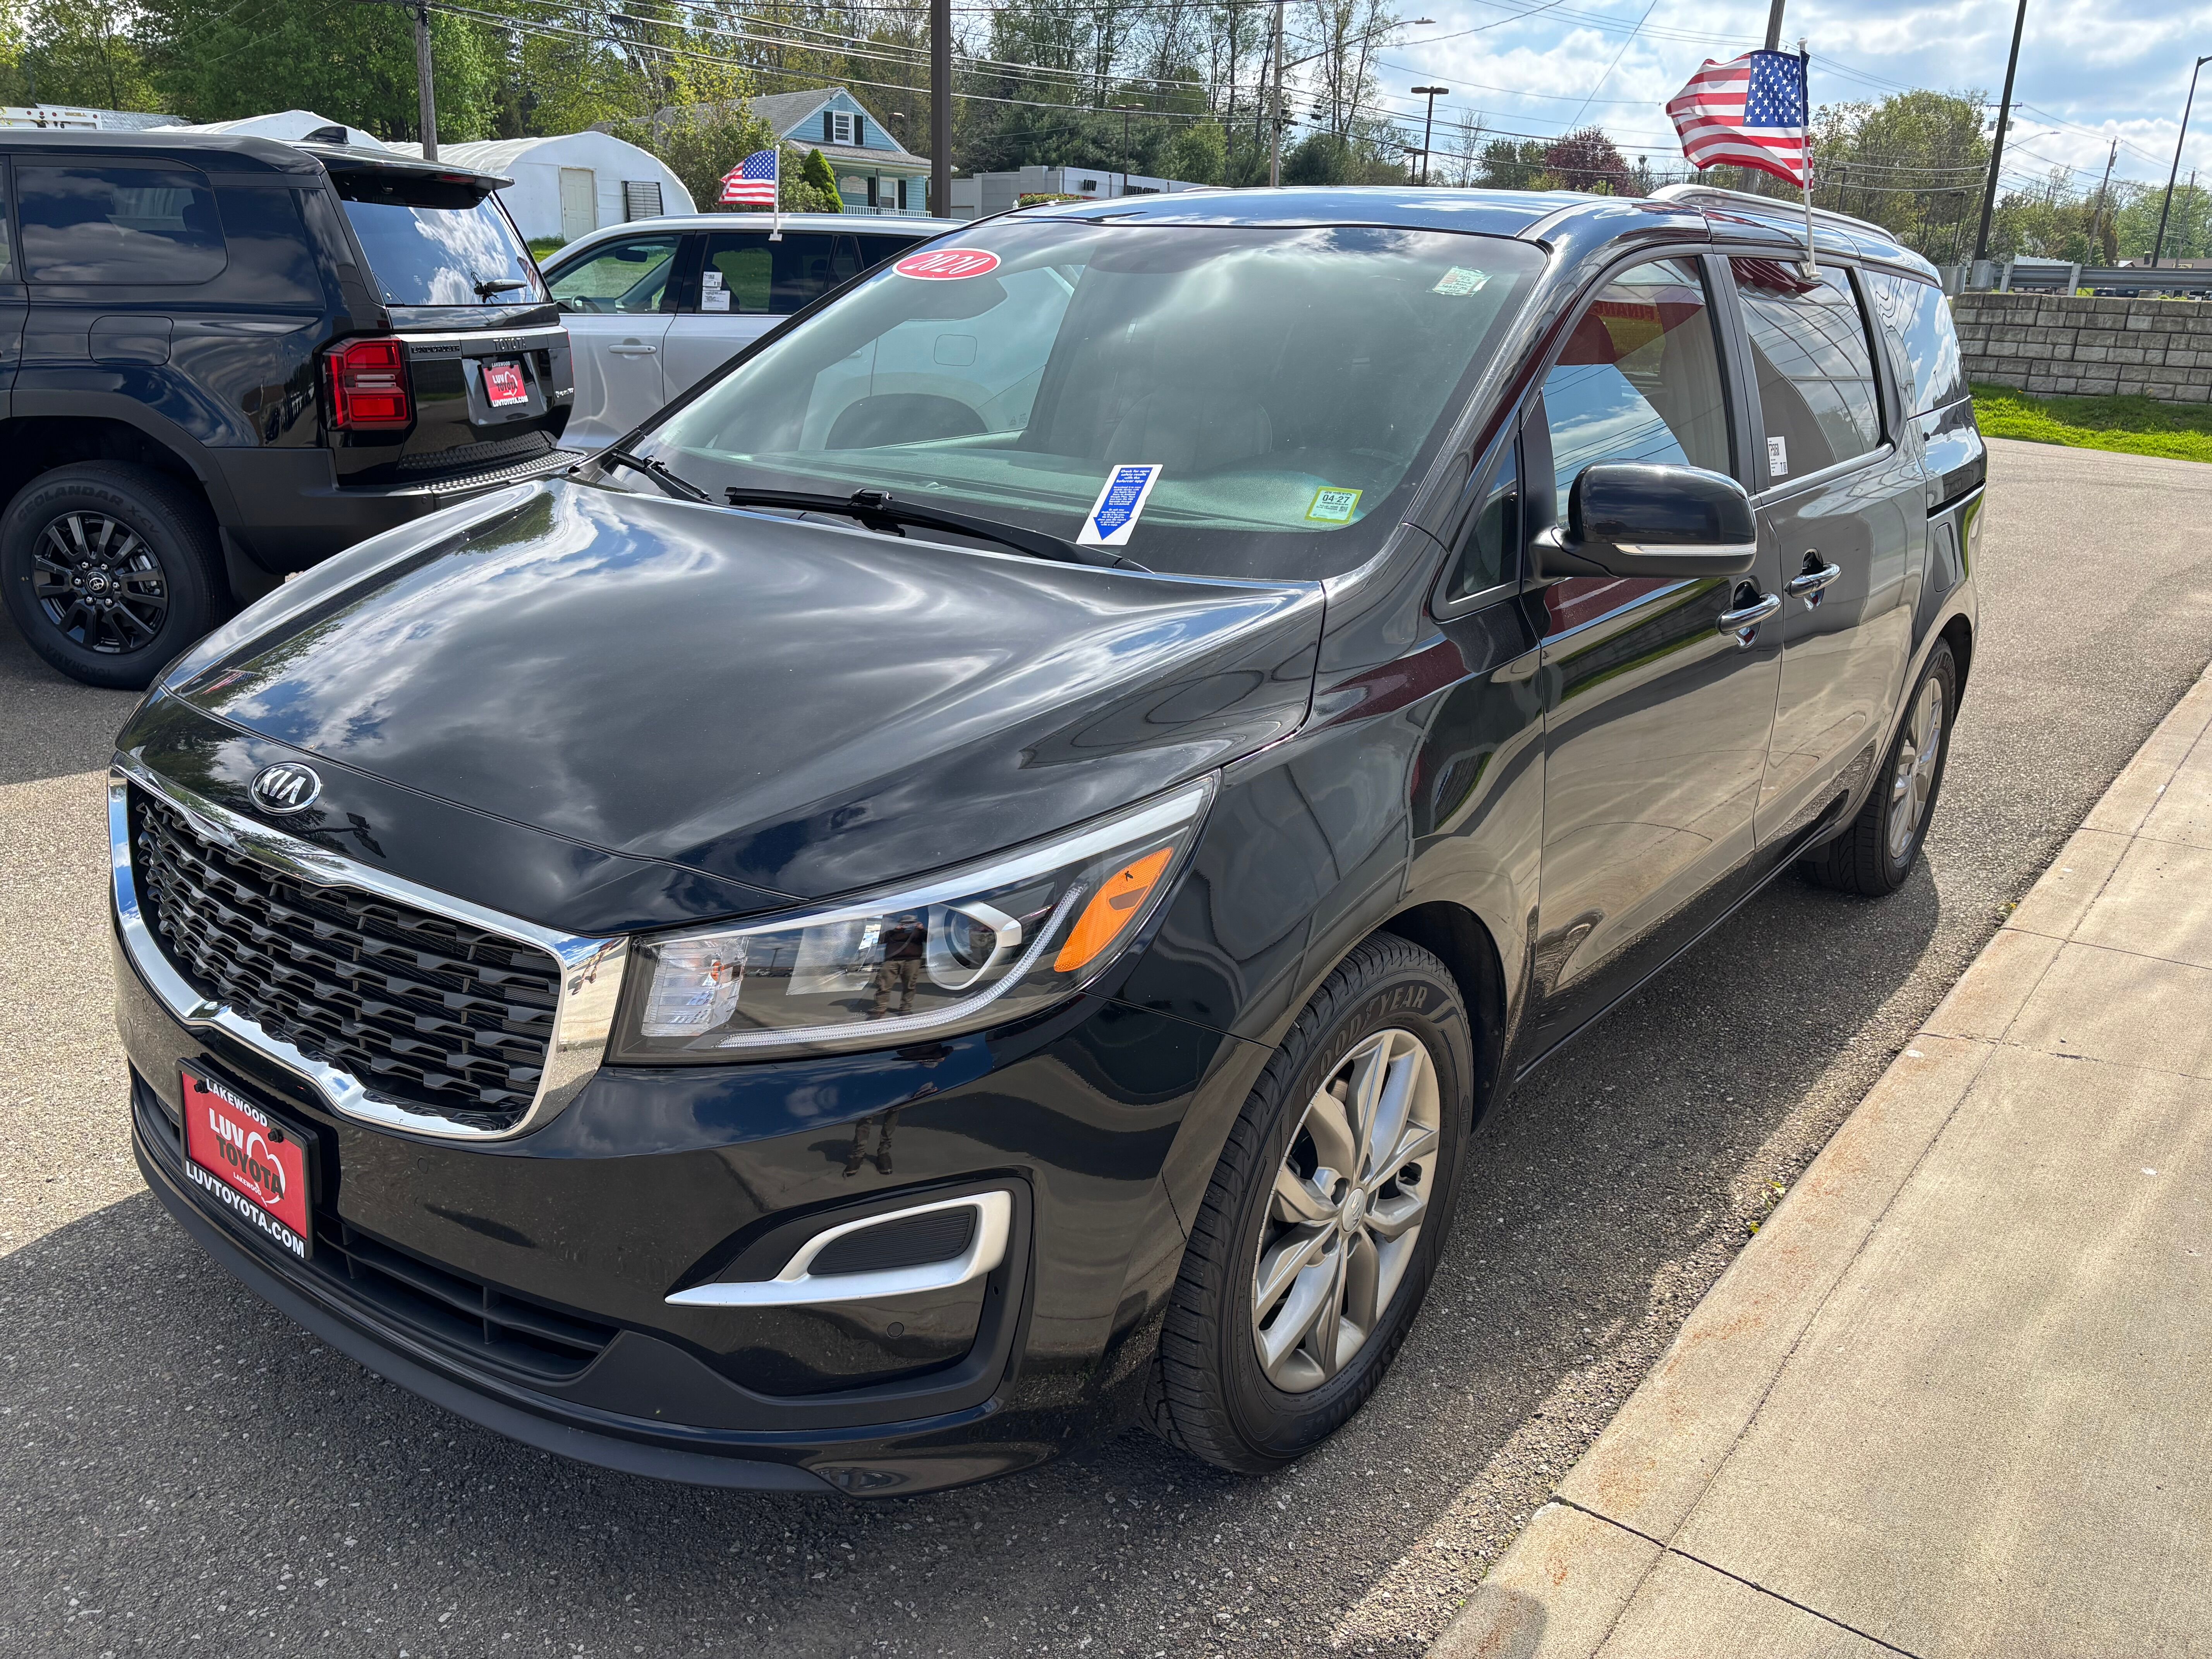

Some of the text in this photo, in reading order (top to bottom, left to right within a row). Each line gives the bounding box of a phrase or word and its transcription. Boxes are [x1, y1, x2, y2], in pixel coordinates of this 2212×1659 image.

[901, 253, 991, 274] 2020
[493, 337, 527, 351] TOYOTA
[492, 374, 504, 383] LUV
[496, 382, 517, 392] TOYOTA
[492, 395, 528, 407] LUVTOYOTA.COM
[17, 486, 160, 534] GEOLANDAR X-CV
[1322, 495, 1350, 503] 04-27
[256, 768, 306, 804] KIA
[1305, 986, 1428, 1099] GOODYEAR
[206, 1079, 267, 1127] LAKEWOOD
[209, 1108, 244, 1149] LUV
[216, 1135, 283, 1199] TOYOTA
[233, 1172, 261, 1196] LAKEWOOD
[186, 1161, 305, 1258] LUVTOYOTA.COM
